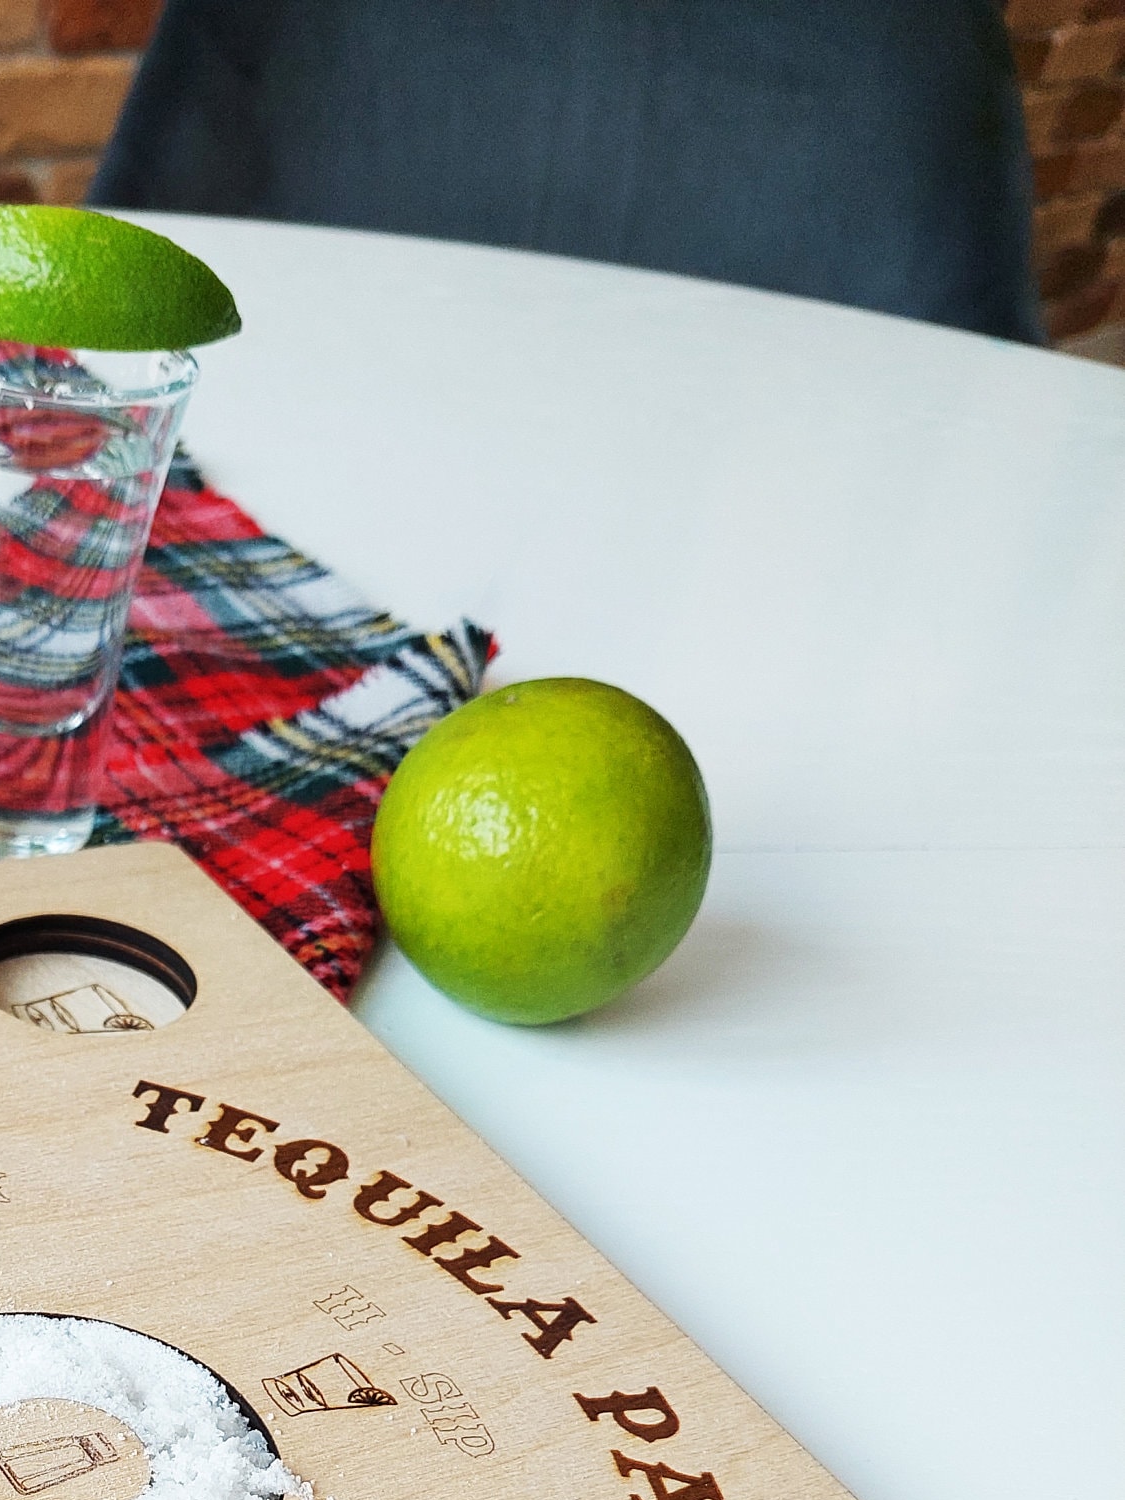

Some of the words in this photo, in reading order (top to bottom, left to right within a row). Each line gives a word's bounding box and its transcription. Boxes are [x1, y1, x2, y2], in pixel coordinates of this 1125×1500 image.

[131, 1079, 598, 1360] TEQUILA
[312, 1283, 387, 1331] II
[400, 1371, 496, 1459] SIP
